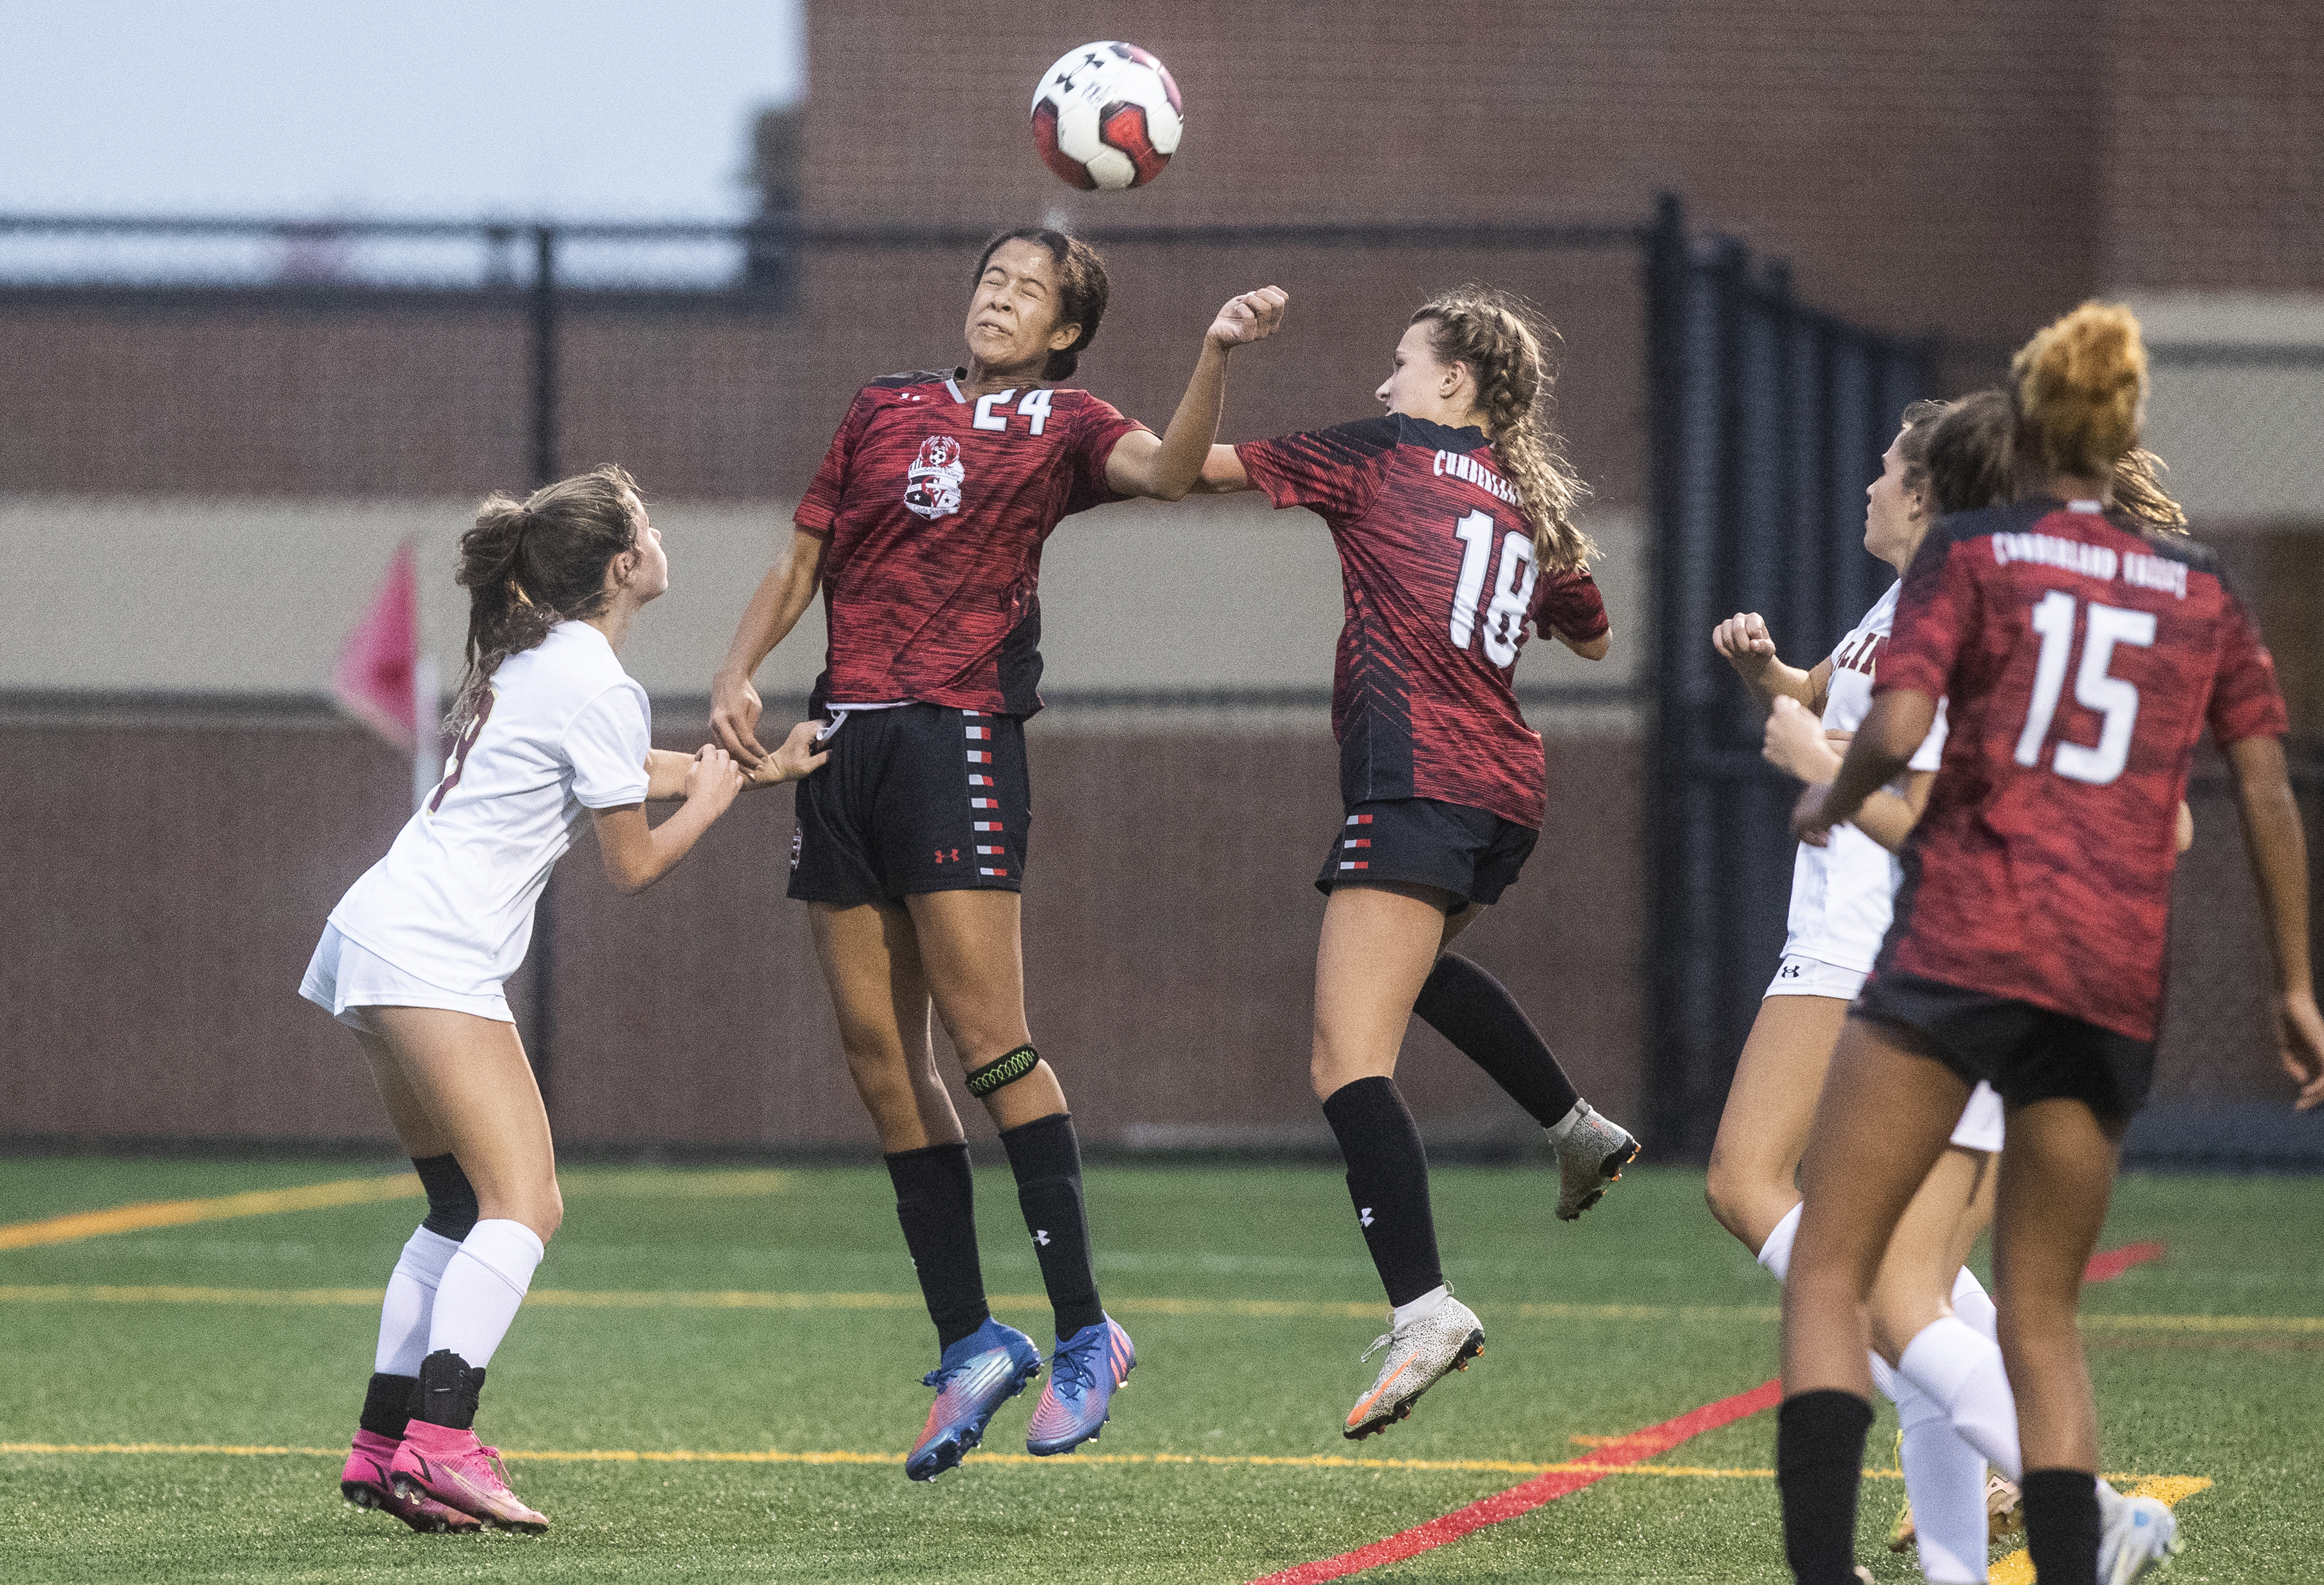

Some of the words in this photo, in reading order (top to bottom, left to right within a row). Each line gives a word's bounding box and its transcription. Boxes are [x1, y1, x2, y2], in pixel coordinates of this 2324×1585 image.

[973, 388, 1054, 435] 24
[944, 469, 960, 479] Valley
[914, 505, 928, 513] Girls
[1450, 509, 1540, 668] 18
[2014, 590, 2157, 785] 15
